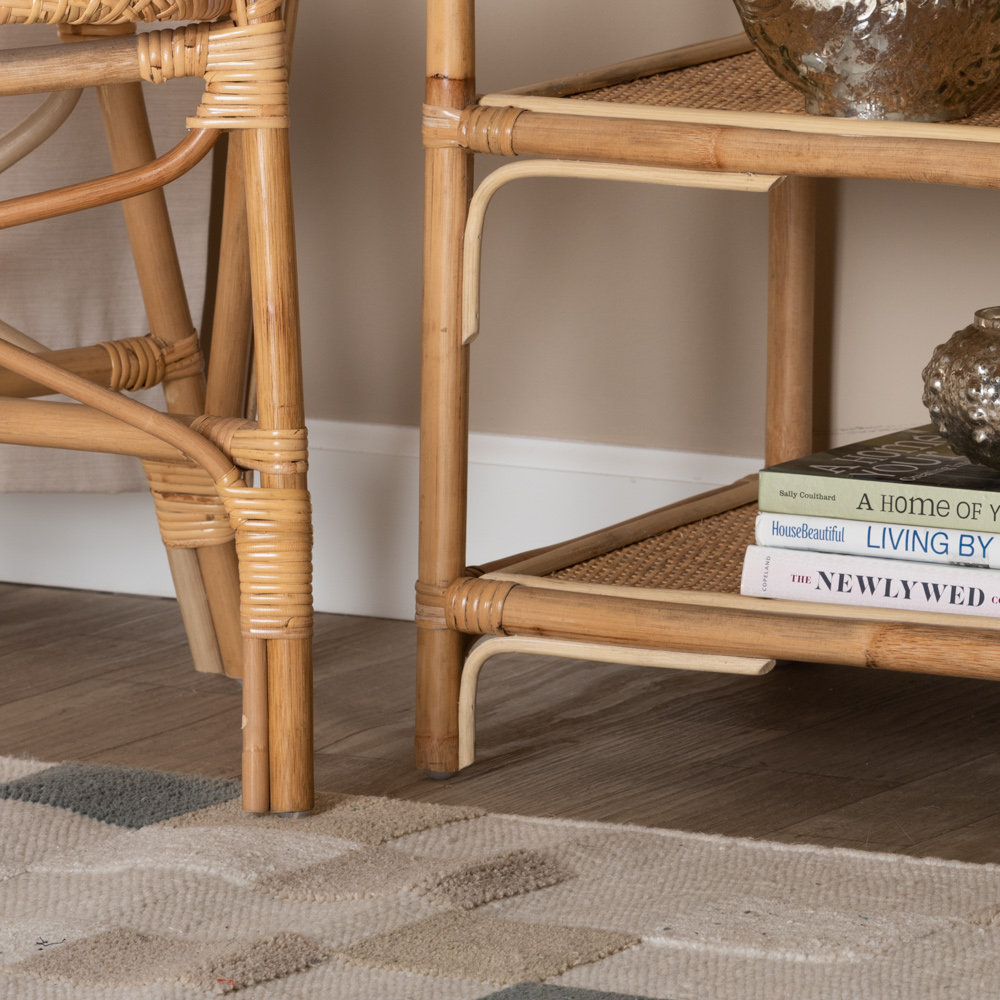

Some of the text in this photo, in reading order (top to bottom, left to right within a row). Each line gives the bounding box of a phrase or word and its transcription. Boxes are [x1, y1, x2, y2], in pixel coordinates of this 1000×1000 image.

[779, 489, 836, 502] Sally Coulthard
[856, 493, 874, 511] A
[956, 501, 982, 520] OF
[866, 526, 950, 555] LIVING
[958, 534, 994, 559] BY
[761, 555, 771, 592] COPELAND
[790, 574, 812, 585] THE
[815, 570, 985, 607] NEWLYWED
